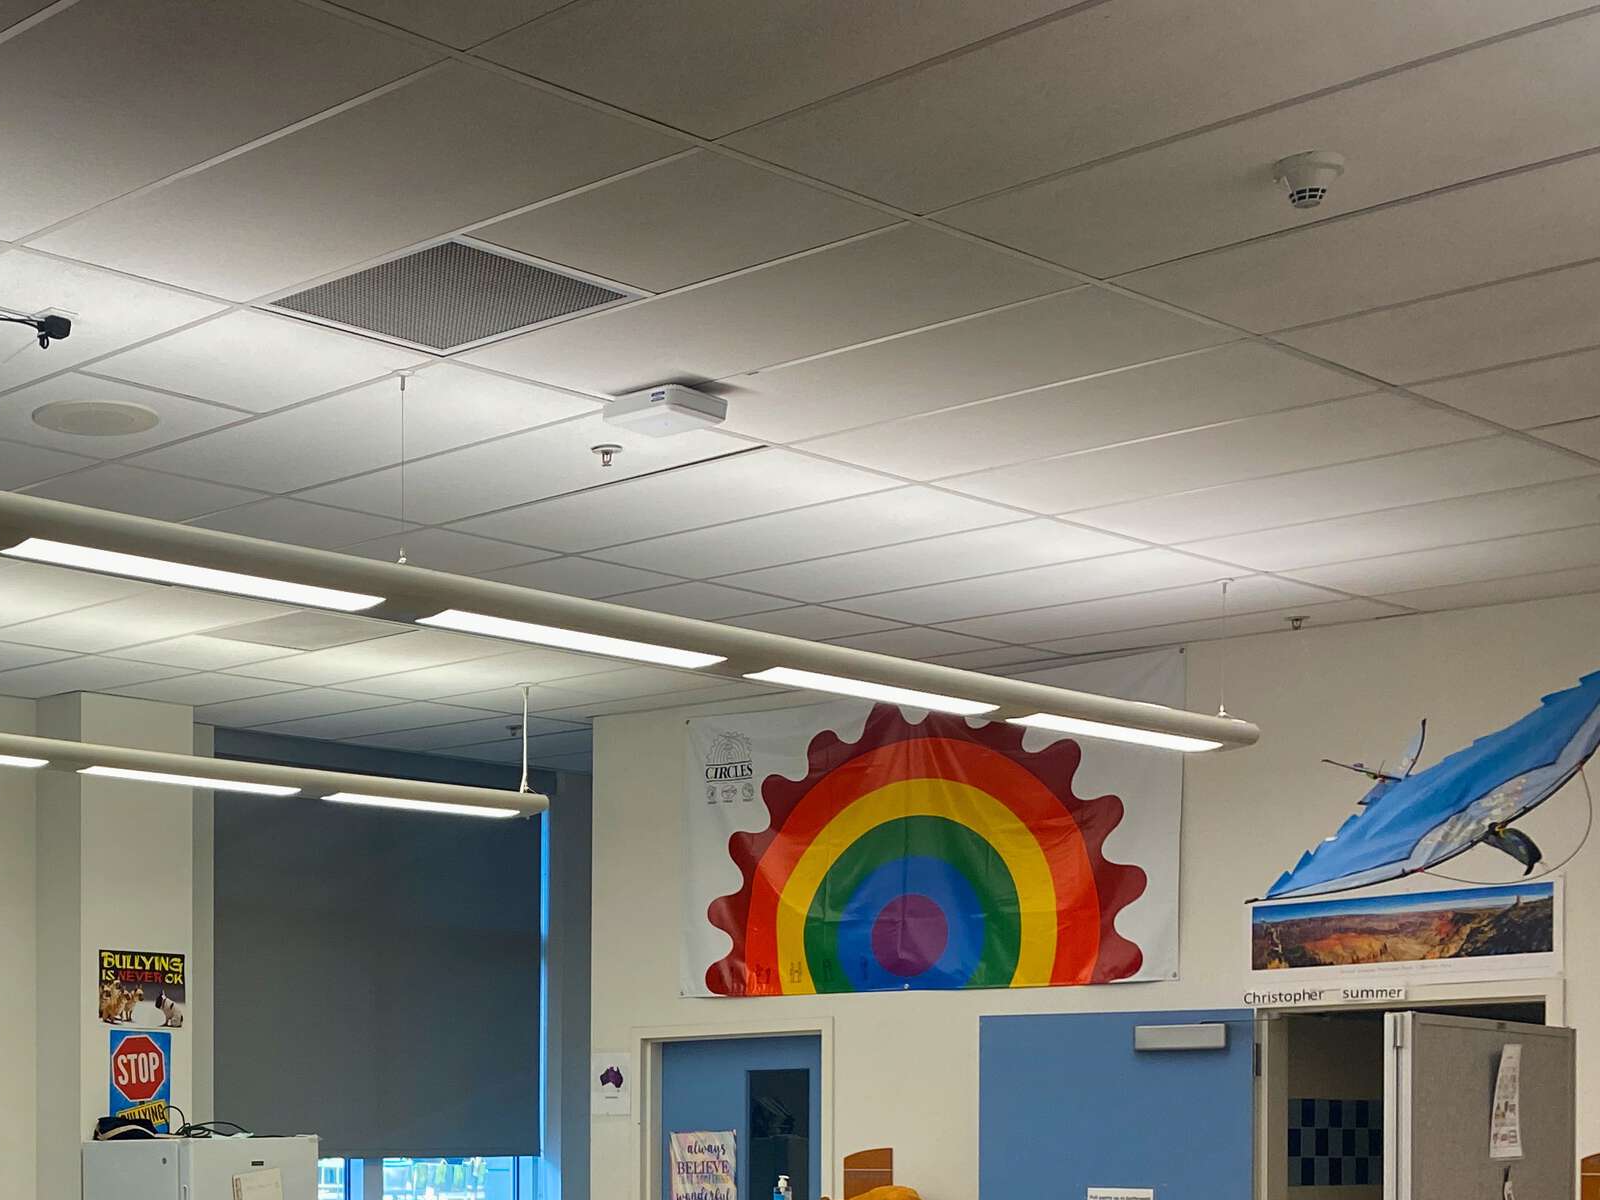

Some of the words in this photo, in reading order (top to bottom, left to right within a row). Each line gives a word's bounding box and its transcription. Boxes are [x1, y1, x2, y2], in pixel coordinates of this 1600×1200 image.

[705, 763, 753, 780] CIRCLES
[101, 951, 183, 973] BULLYING
[102, 969, 115, 980] IS
[118, 970, 162, 983] NEVER
[165, 973, 183, 985] OK
[1243, 989, 1325, 1005] Christopher
[1342, 988, 1403, 999] summer
[117, 1052, 160, 1085] STOP
[687, 1141, 726, 1160] always
[677, 1160, 730, 1175] BELIEVE
